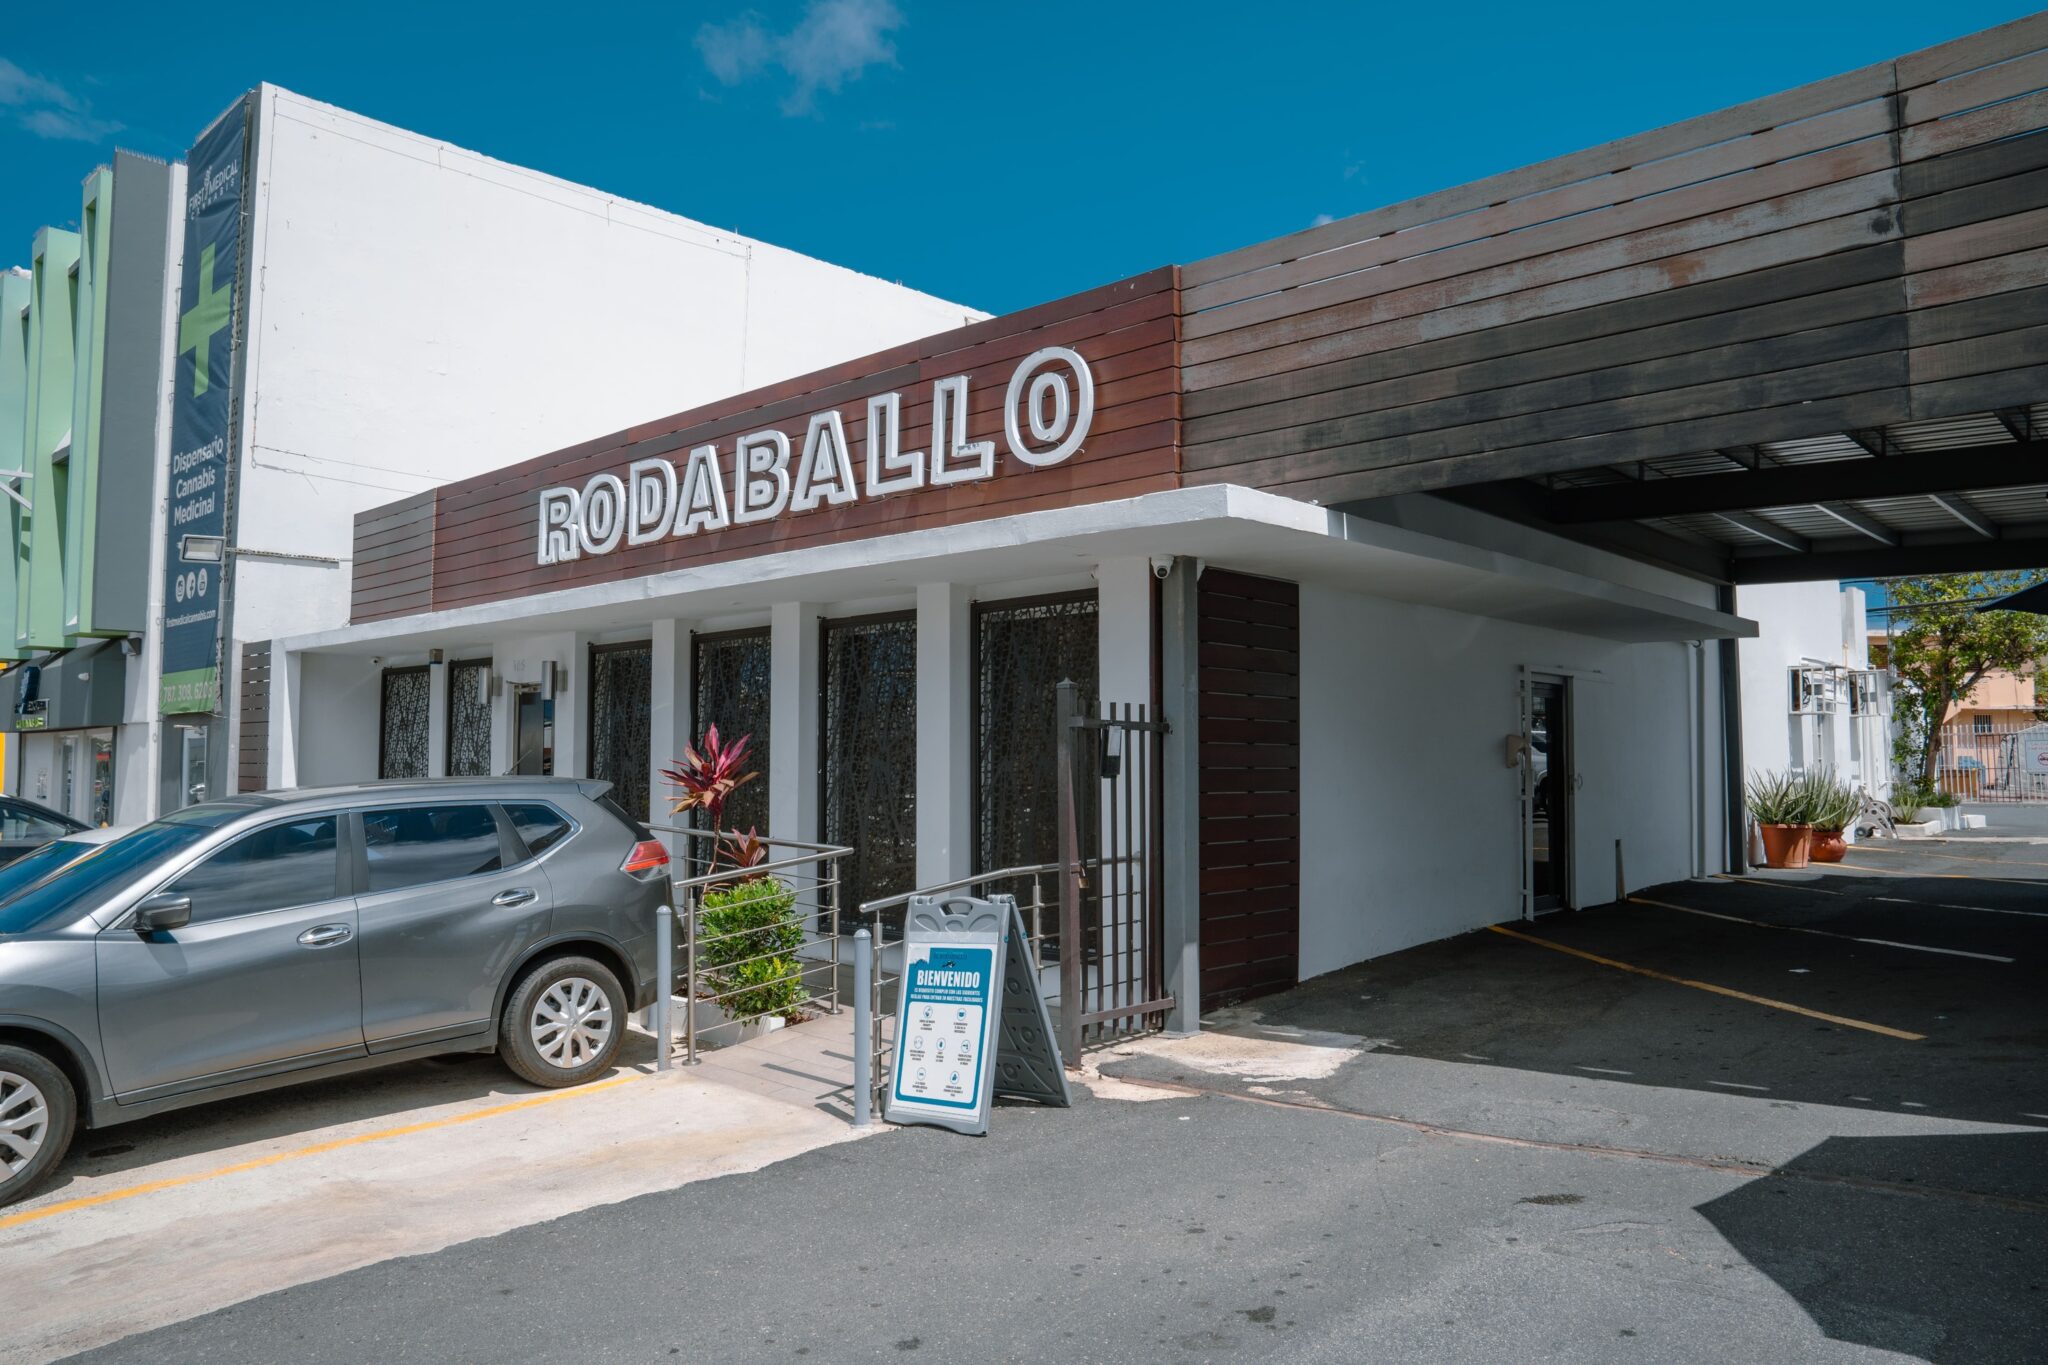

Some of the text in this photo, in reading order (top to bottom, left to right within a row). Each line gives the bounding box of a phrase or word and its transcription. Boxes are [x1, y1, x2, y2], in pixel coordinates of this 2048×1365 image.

[189, 160, 238, 213] FIRST MEDICAL
[190, 178, 235, 220] CANNABIS
[173, 435, 224, 475] Dispensario
[538, 346, 1095, 565] RODABALLO
[176, 466, 216, 498] Cannabis
[173, 491, 215, 526] Medicinal
[916, 969, 980, 989] BIENVENIDO
